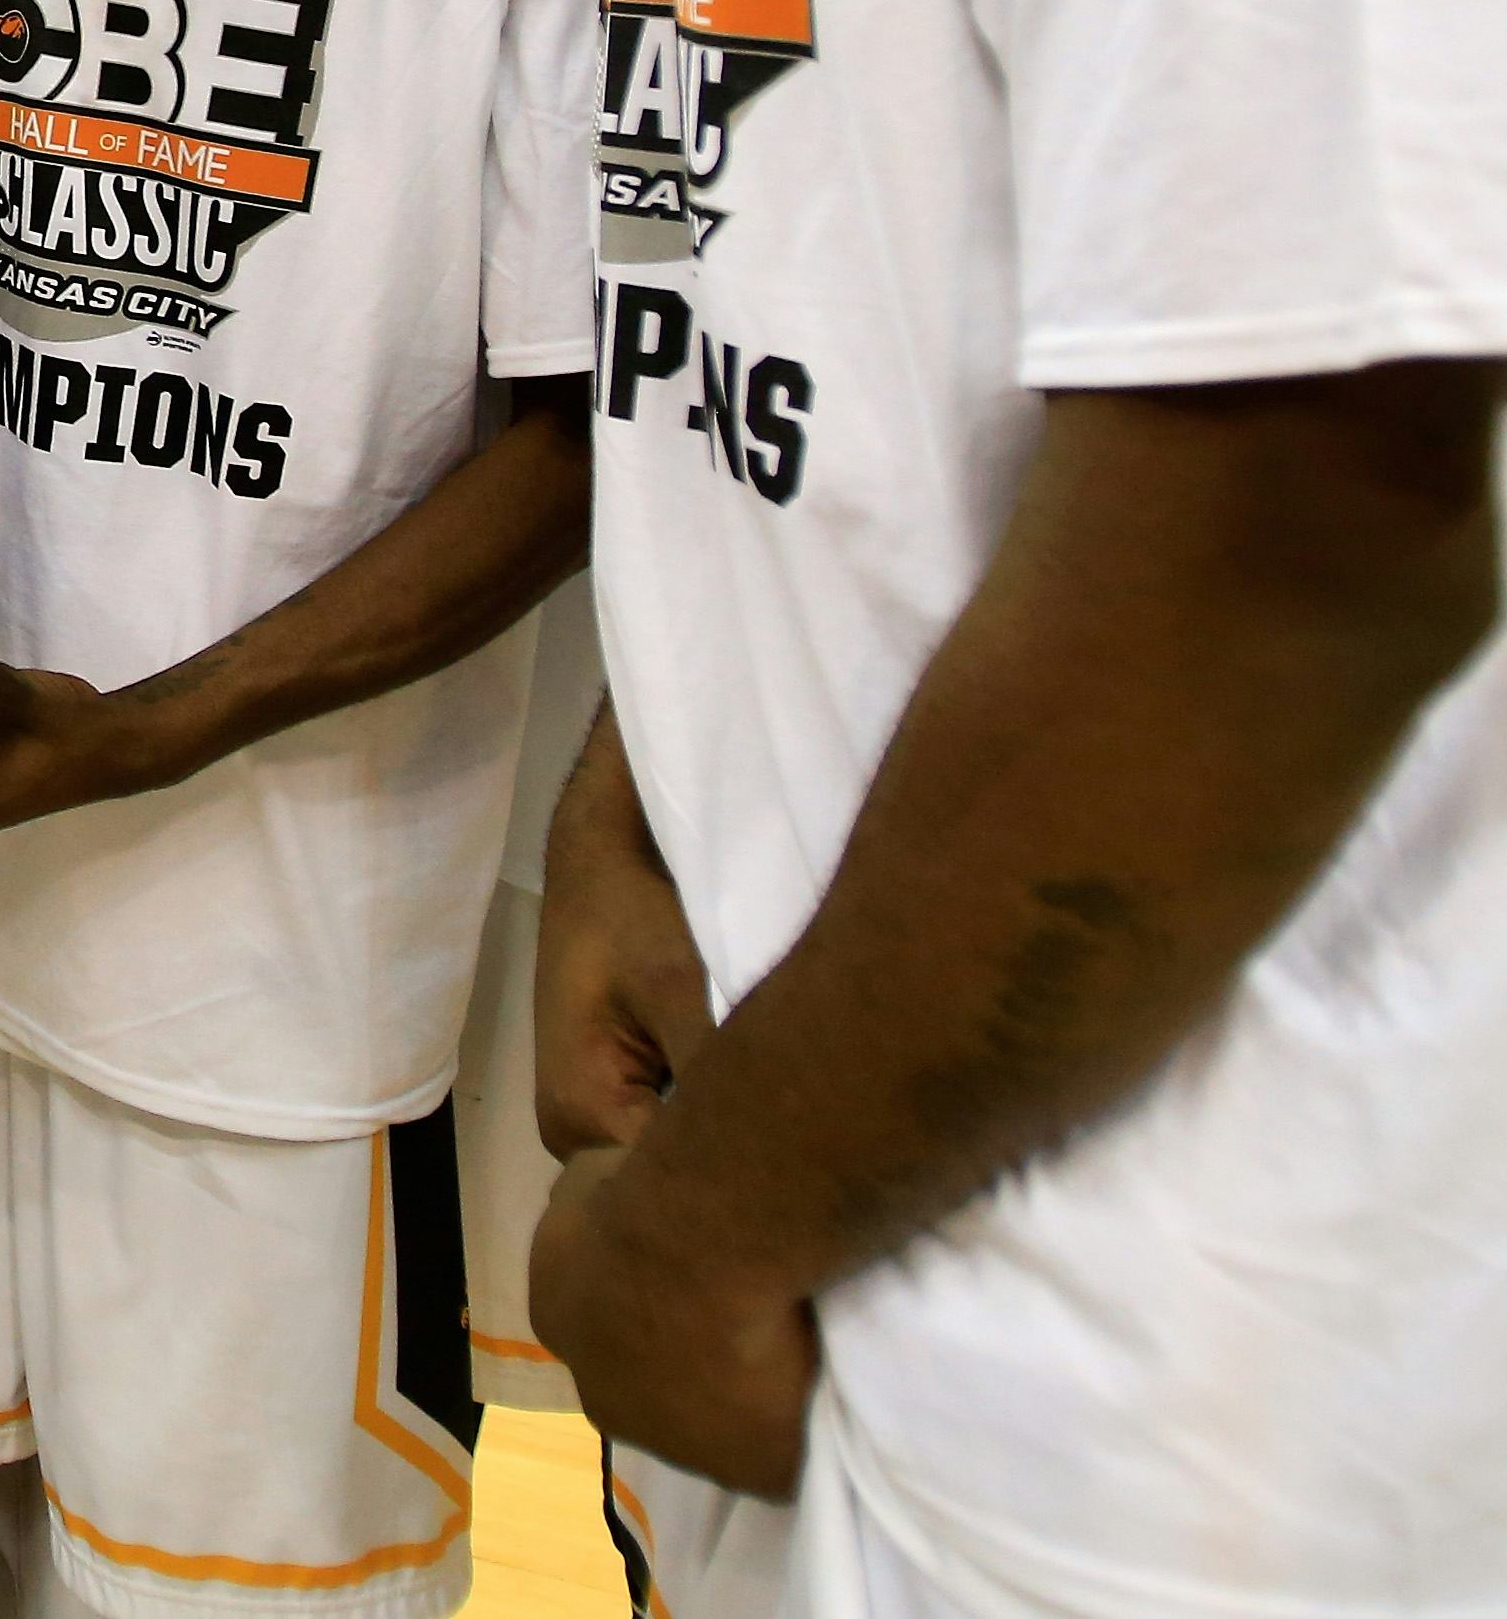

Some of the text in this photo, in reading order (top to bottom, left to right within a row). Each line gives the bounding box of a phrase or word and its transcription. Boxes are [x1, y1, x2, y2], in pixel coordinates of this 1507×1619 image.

[10, 106, 231, 185] HALL OF FAME
[127, 295, 218, 329] CITY
